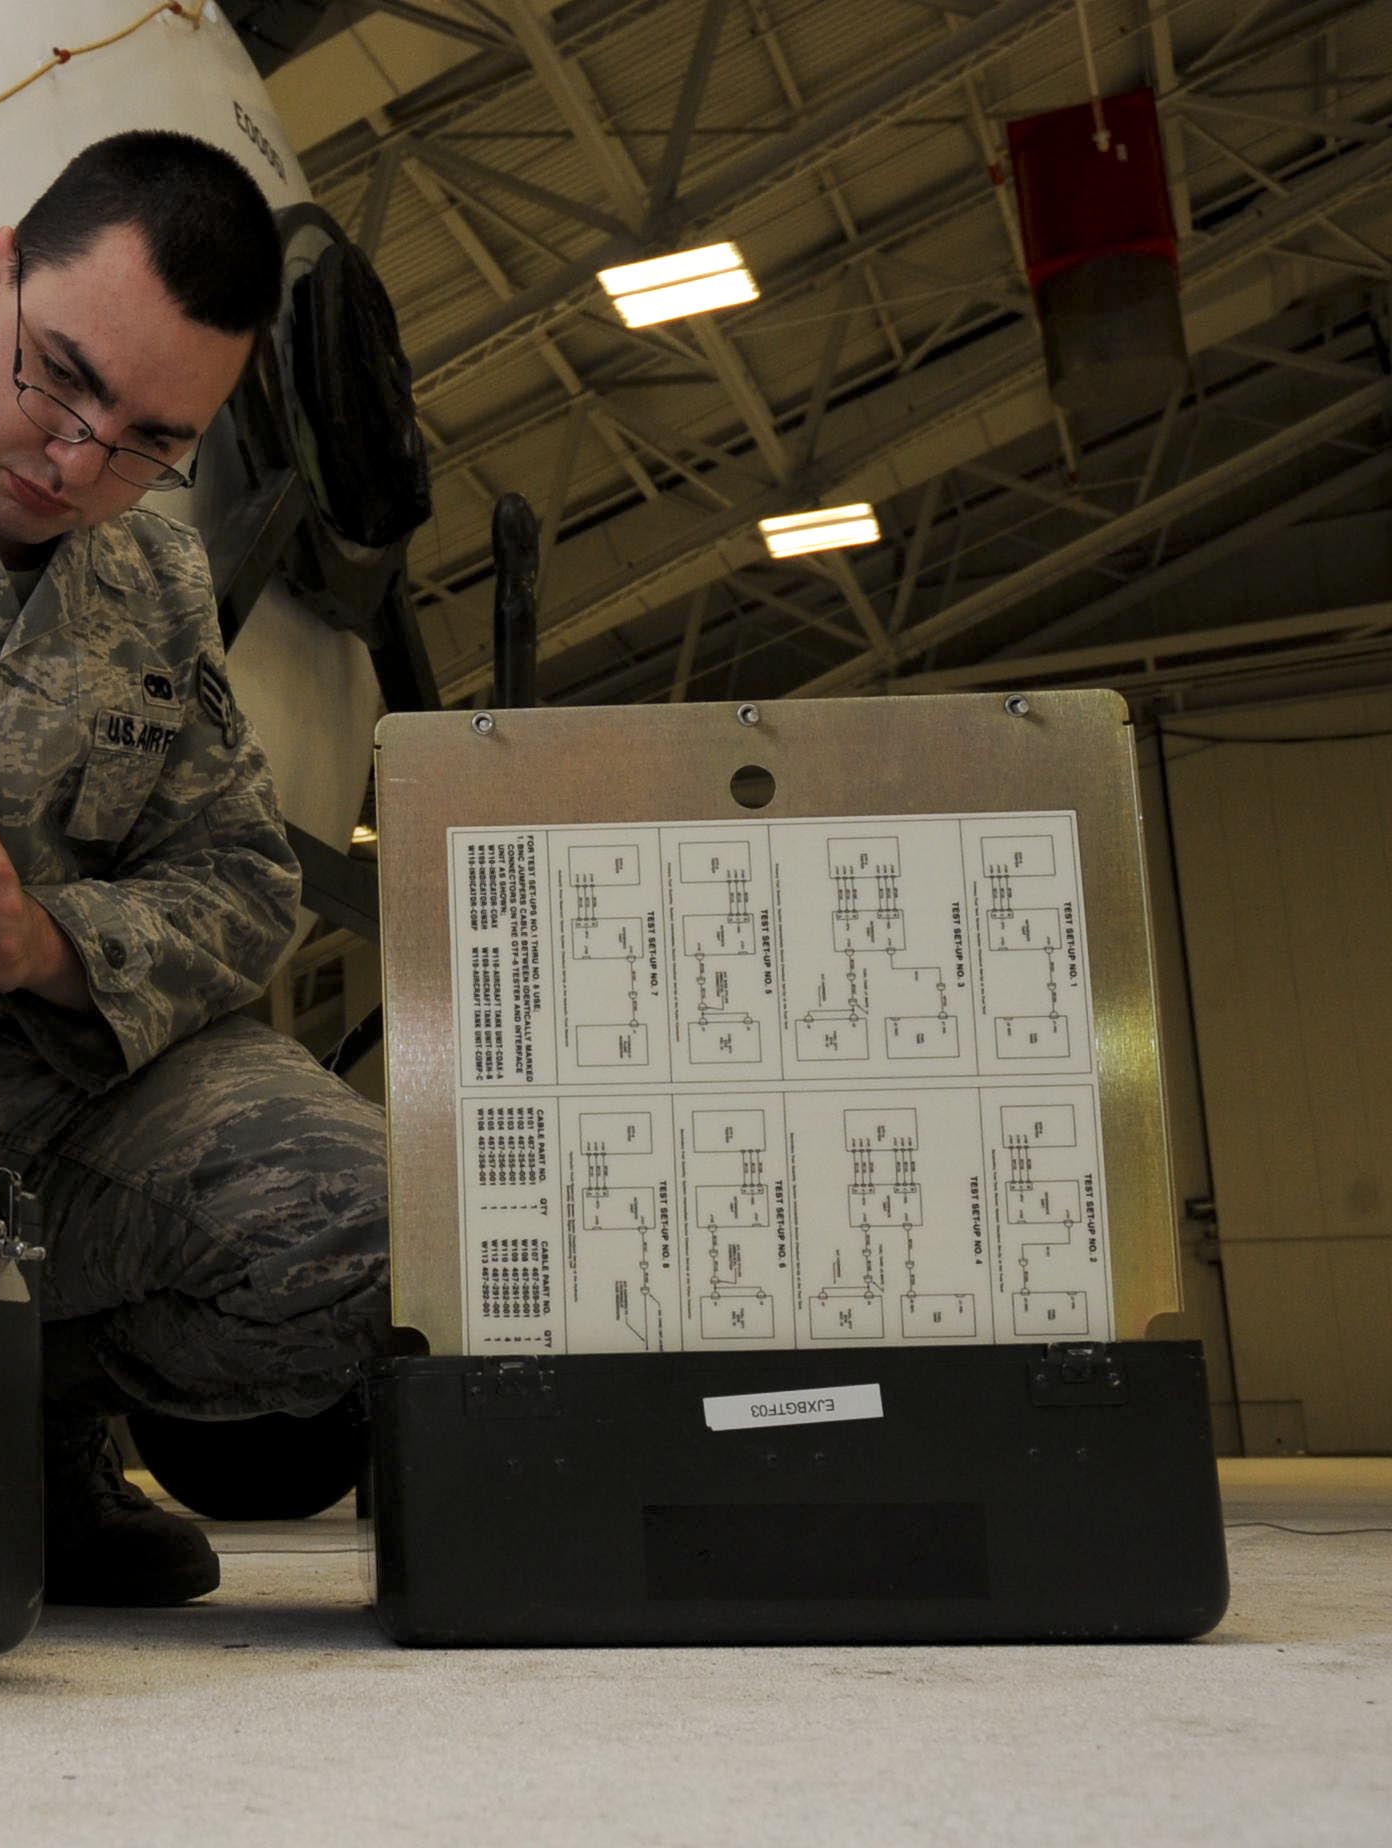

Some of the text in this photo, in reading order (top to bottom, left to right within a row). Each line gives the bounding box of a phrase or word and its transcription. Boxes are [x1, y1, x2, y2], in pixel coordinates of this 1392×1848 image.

[108, 716, 135, 747] U.S.
[136, 725, 162, 752] AIR
[497, 843, 505, 863] UNIT
[516, 843, 525, 861] BNC
[526, 835, 534, 853] FOR
[506, 843, 517, 903] CONNECTORS
[527, 855, 535, 876] TEST
[517, 863, 526, 905] JUMPERS
[528, 879, 536, 915] SET-UPS
[519, 907, 528, 936] CABLE
[646, 910, 656, 934] TEST
[760, 908, 769, 932] TEST
[951, 901, 960, 924] TEST
[1063, 901, 1073, 924] TEST
[510, 920, 518, 937] THE
[530, 940, 538, 964] THRU
[647, 936, 657, 970] SET-UP
[761, 934, 771, 968] SET-UP
[953, 927, 963, 961] SET-UP
[1065, 927, 1076, 961] SET-UP
[520, 939, 529, 982] BETWEEN
[955, 963, 964, 979] NO.
[1068, 962, 1077, 980] NO.
[512, 967, 520, 1001] TESTER
[531, 966, 540, 981] NO.
[649, 972, 658, 988] NO.
[763, 970, 772, 986] NO.
[473, 1009, 481, 1028] TANK
[483, 1009, 491, 1028] TANK
[494, 1009, 502, 1028] TANK
[513, 1003, 521, 1022] AND
[522, 984, 532, 1041] IDENTICALLY
[514, 1024, 523, 1073] INTERFACE
[524, 1043, 533, 1082] MARKED
[535, 1108, 548, 1216] CABLE PART NO. QTY
[658, 1180, 668, 1204] TEST
[774, 1179, 784, 1204] TEST
[969, 1175, 979, 1200] TEST
[1083, 1173, 1094, 1197] TEST
[659, 1206, 669, 1241] SET-UP
[775, 1206, 785, 1241] SET-UP
[971, 1202, 981, 1237] SET-UP
[1085, 1200, 1096, 1235] SET-UP
[661, 1243, 670, 1260] NO.
[777, 1243, 786, 1260] NO.
[973, 1239, 982, 1256] NO.
[1088, 1237, 1097, 1255] NO.
[540, 1240, 552, 1348] CABLE PART NO. QTY
[750, 1399, 835, 1418] EJXBGTF03
